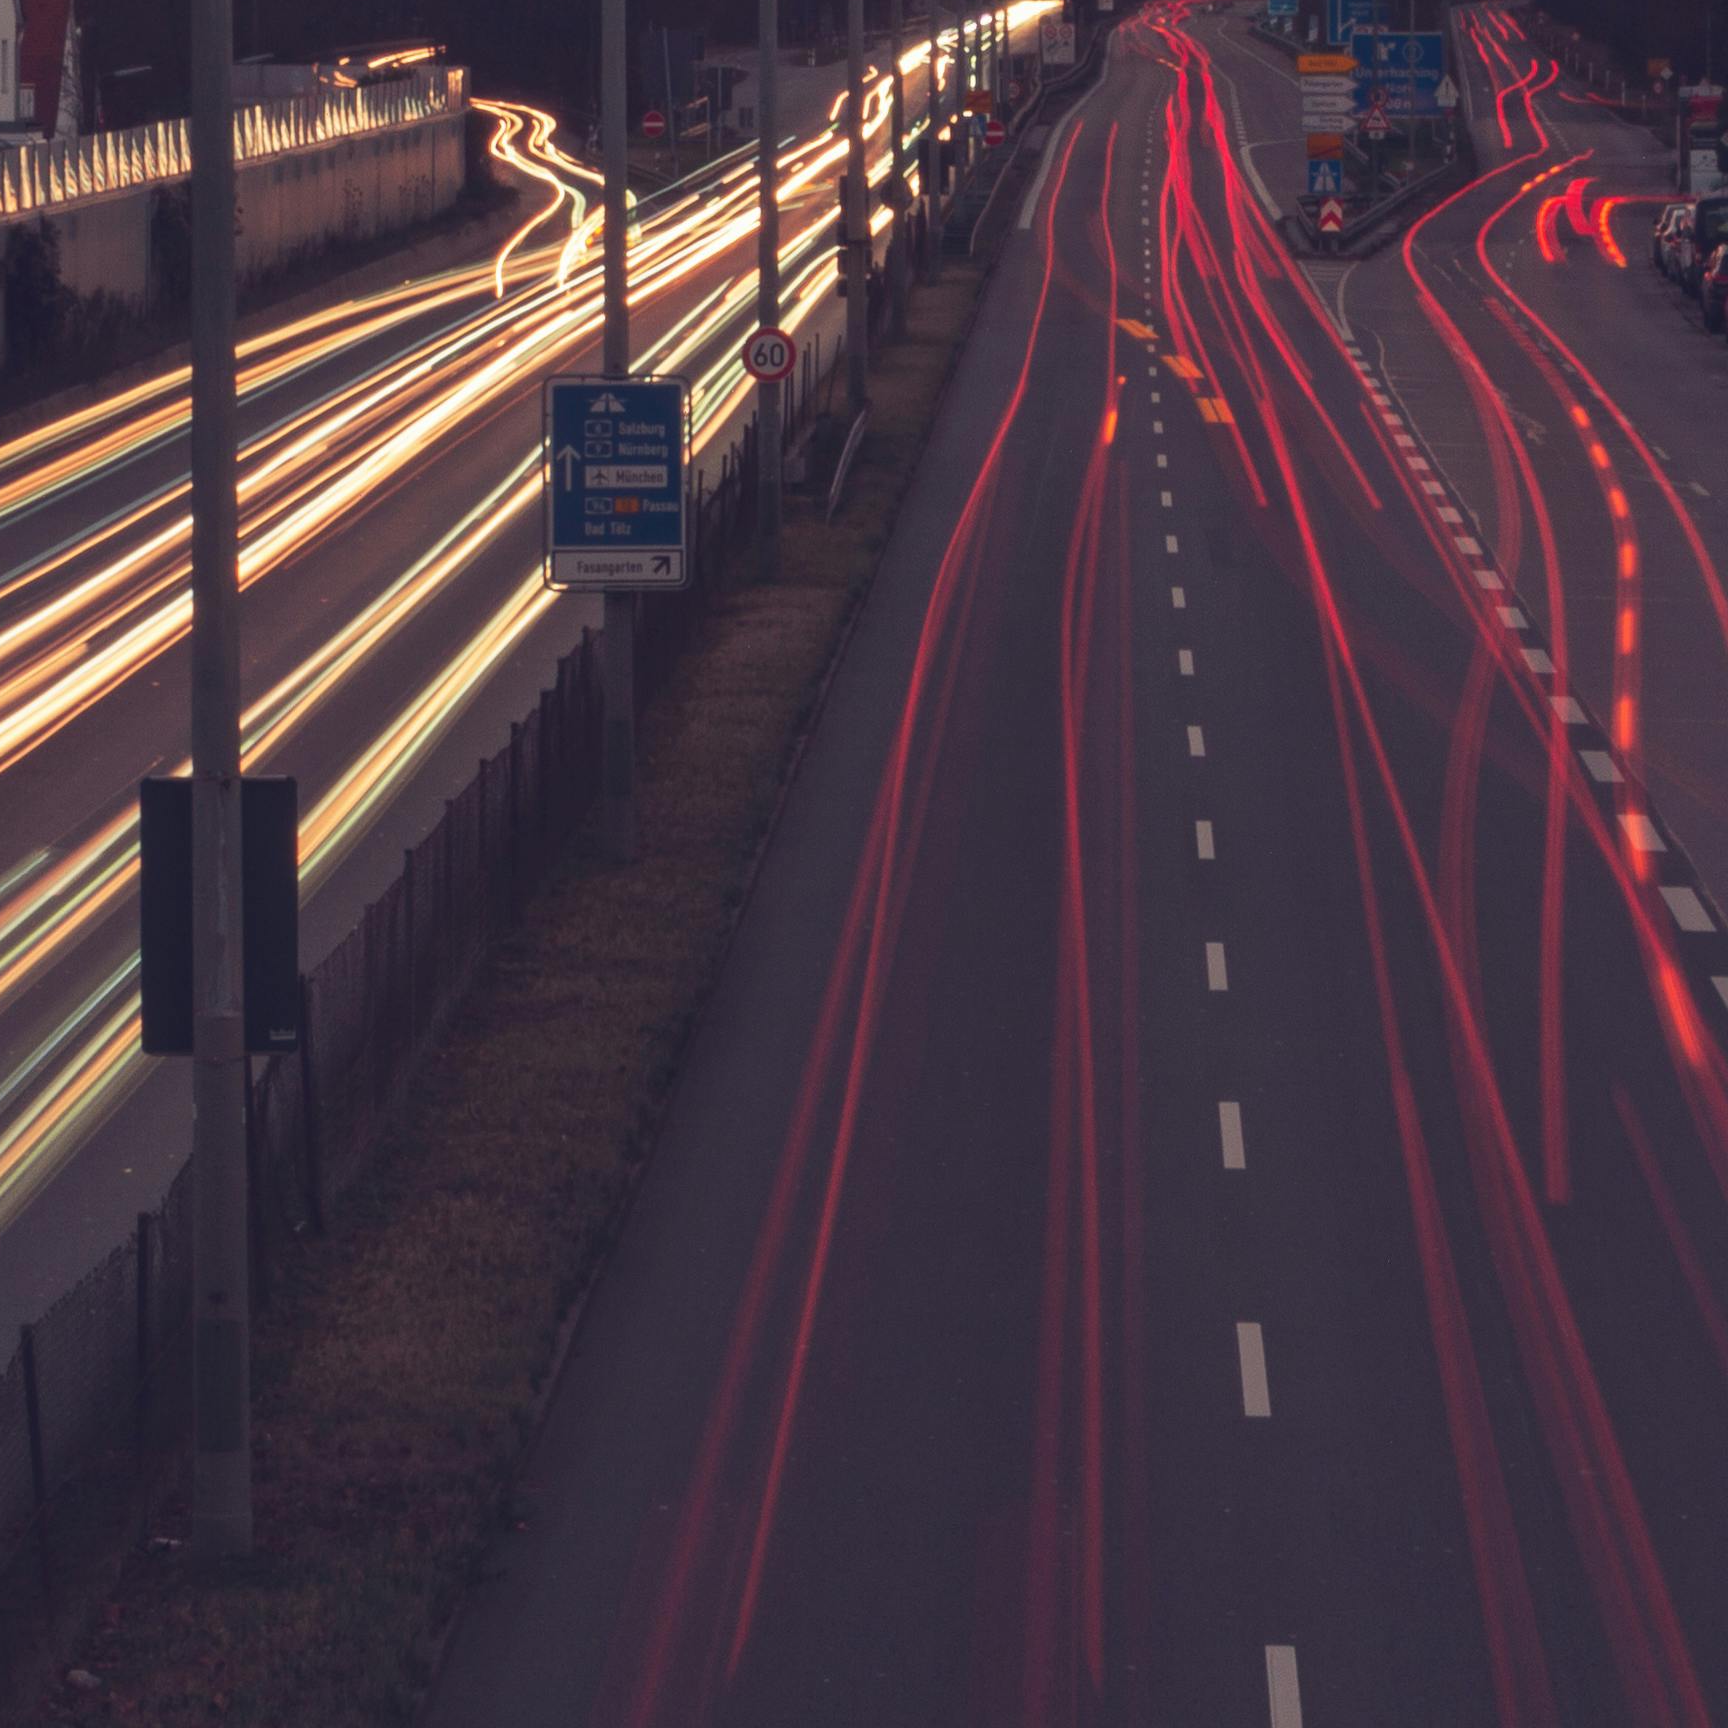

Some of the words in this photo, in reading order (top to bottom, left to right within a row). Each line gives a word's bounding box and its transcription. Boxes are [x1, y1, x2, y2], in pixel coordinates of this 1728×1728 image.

[1354, 66, 1440, 82] Unerhaching
[753, 343, 785, 368] 60
[618, 421, 666, 438] Salzburg
[618, 442, 669, 458] Nürnberg
[616, 470, 664, 484] München
[642, 498, 679, 512] Passau
[585, 522, 604, 535] Bad
[610, 521, 631, 535] Tölz
[577, 561, 643, 576] Fasangarten
